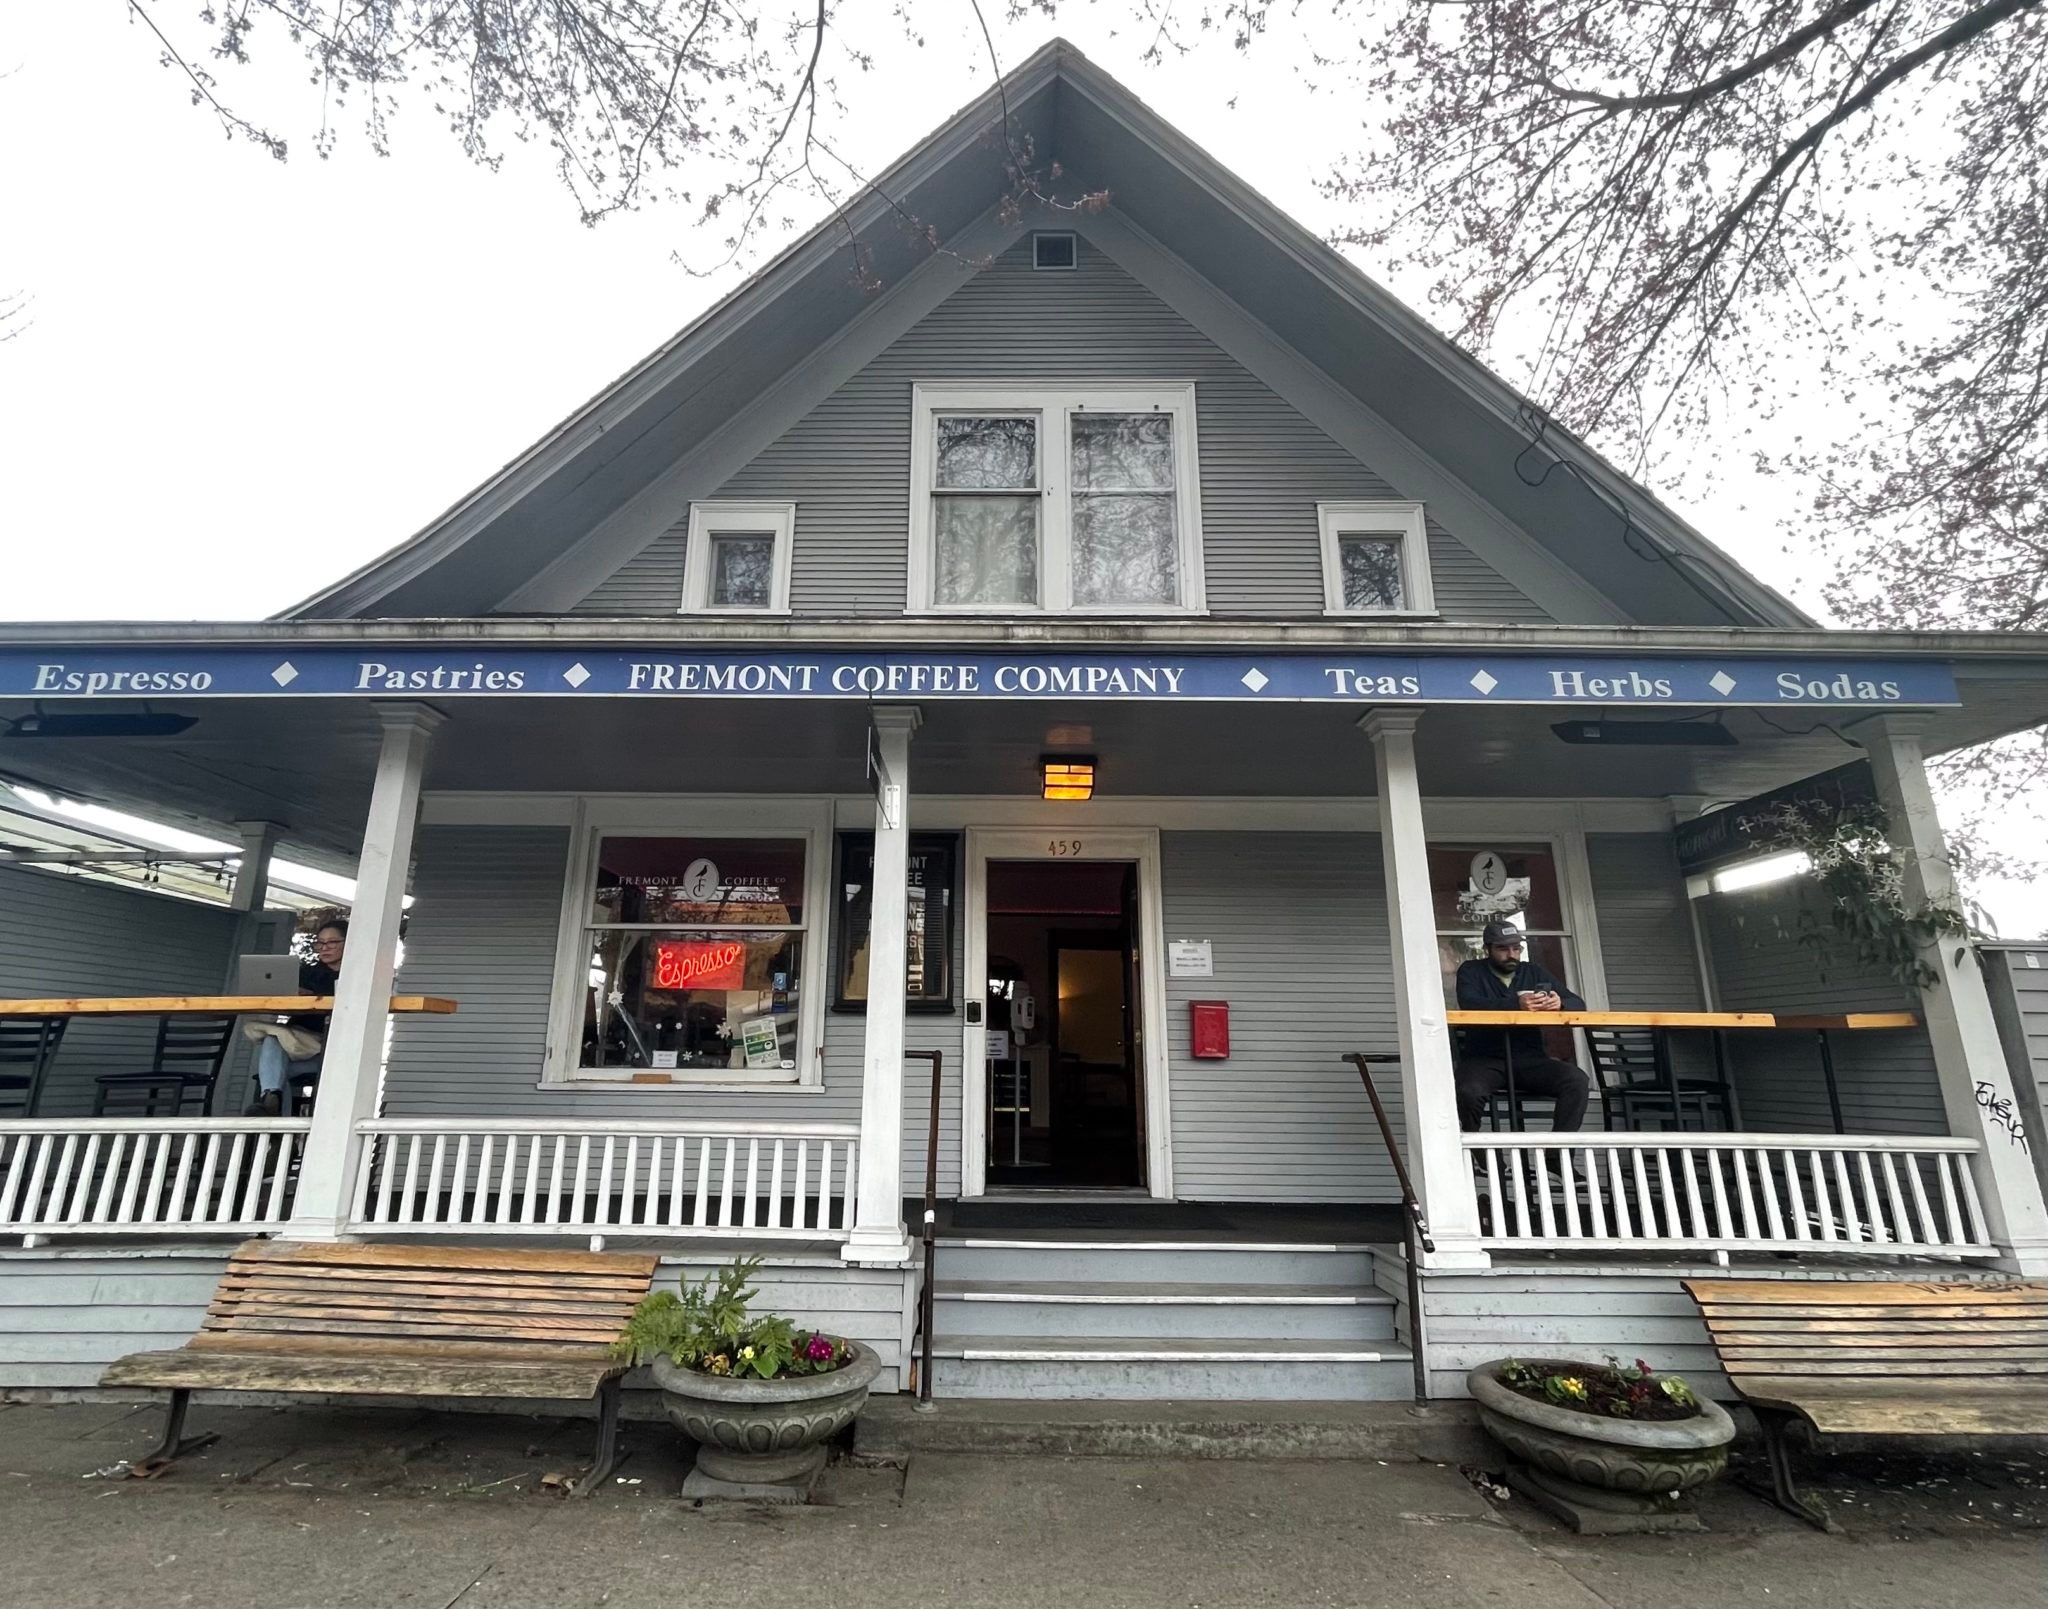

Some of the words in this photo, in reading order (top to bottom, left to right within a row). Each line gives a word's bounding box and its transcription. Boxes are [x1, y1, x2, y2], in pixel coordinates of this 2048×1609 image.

[32, 664, 213, 696] Espresso
[355, 661, 526, 690] Pastries
[627, 663, 820, 692] FREMONT
[831, 664, 980, 693] COFFEE
[993, 665, 1185, 694] COMPANY
[1324, 667, 1420, 695] Teas
[1548, 670, 1673, 699] Herbs
[1777, 672, 1901, 702] Sodas
[1048, 840, 1082, 856] 459
[618, 876, 678, 886] FREMONT
[724, 876, 769, 886] COFFEE
[657, 945, 741, 989] Espresso
